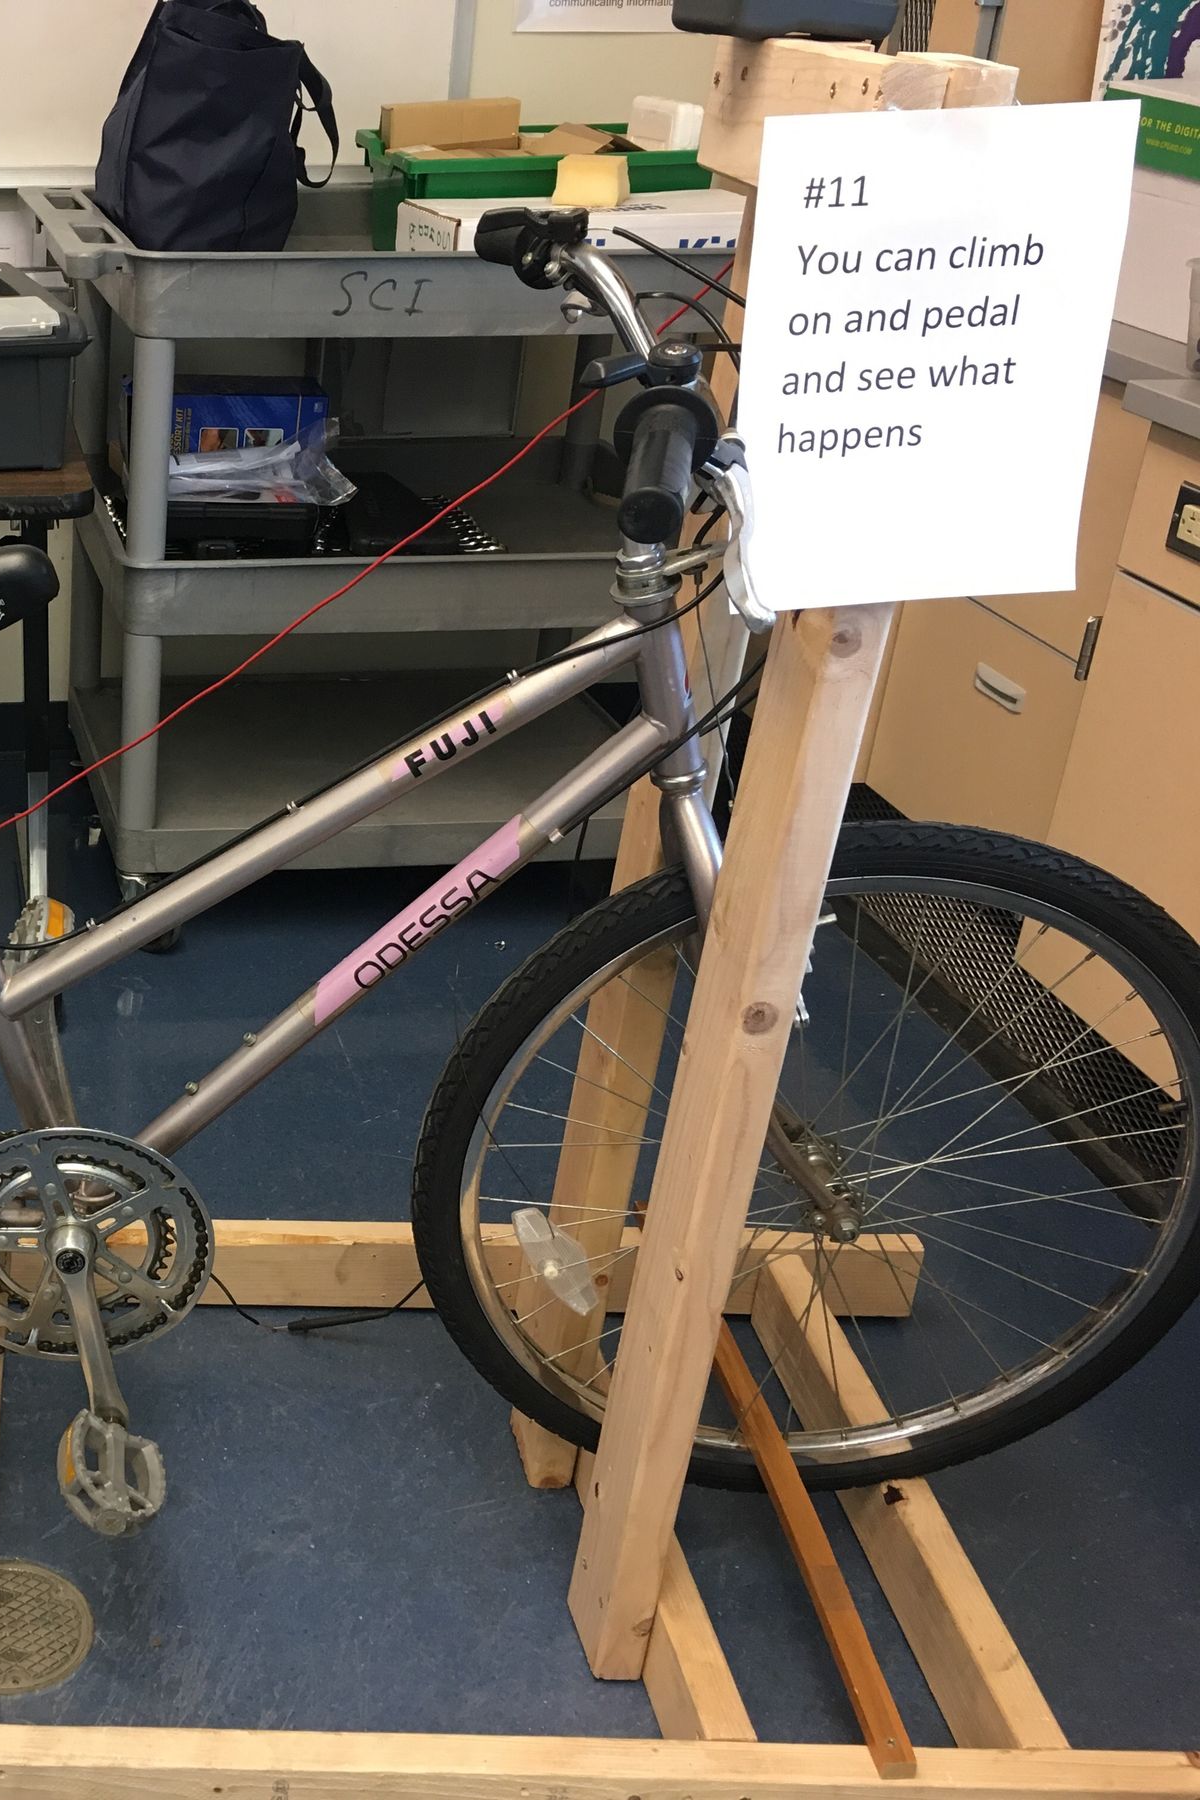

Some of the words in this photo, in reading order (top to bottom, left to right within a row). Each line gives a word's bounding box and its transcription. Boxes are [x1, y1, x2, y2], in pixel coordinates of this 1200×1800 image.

[1155, 120, 1172, 133] THE
[804, 175, 869, 209] #11
[797, 244, 862, 275] You
[875, 246, 936, 272] can
[949, 233, 1044, 269] climb
[332, 271, 433, 317] SCI
[788, 311, 831, 336] on
[844, 299, 912, 333] and
[922, 294, 1020, 337] pedal
[782, 361, 846, 395] and
[857, 366, 916, 391] see
[928, 355, 1017, 387] what
[777, 423, 924, 459] happens
[404, 710, 497, 779] FUJI
[353, 869, 500, 989] ODESSA
